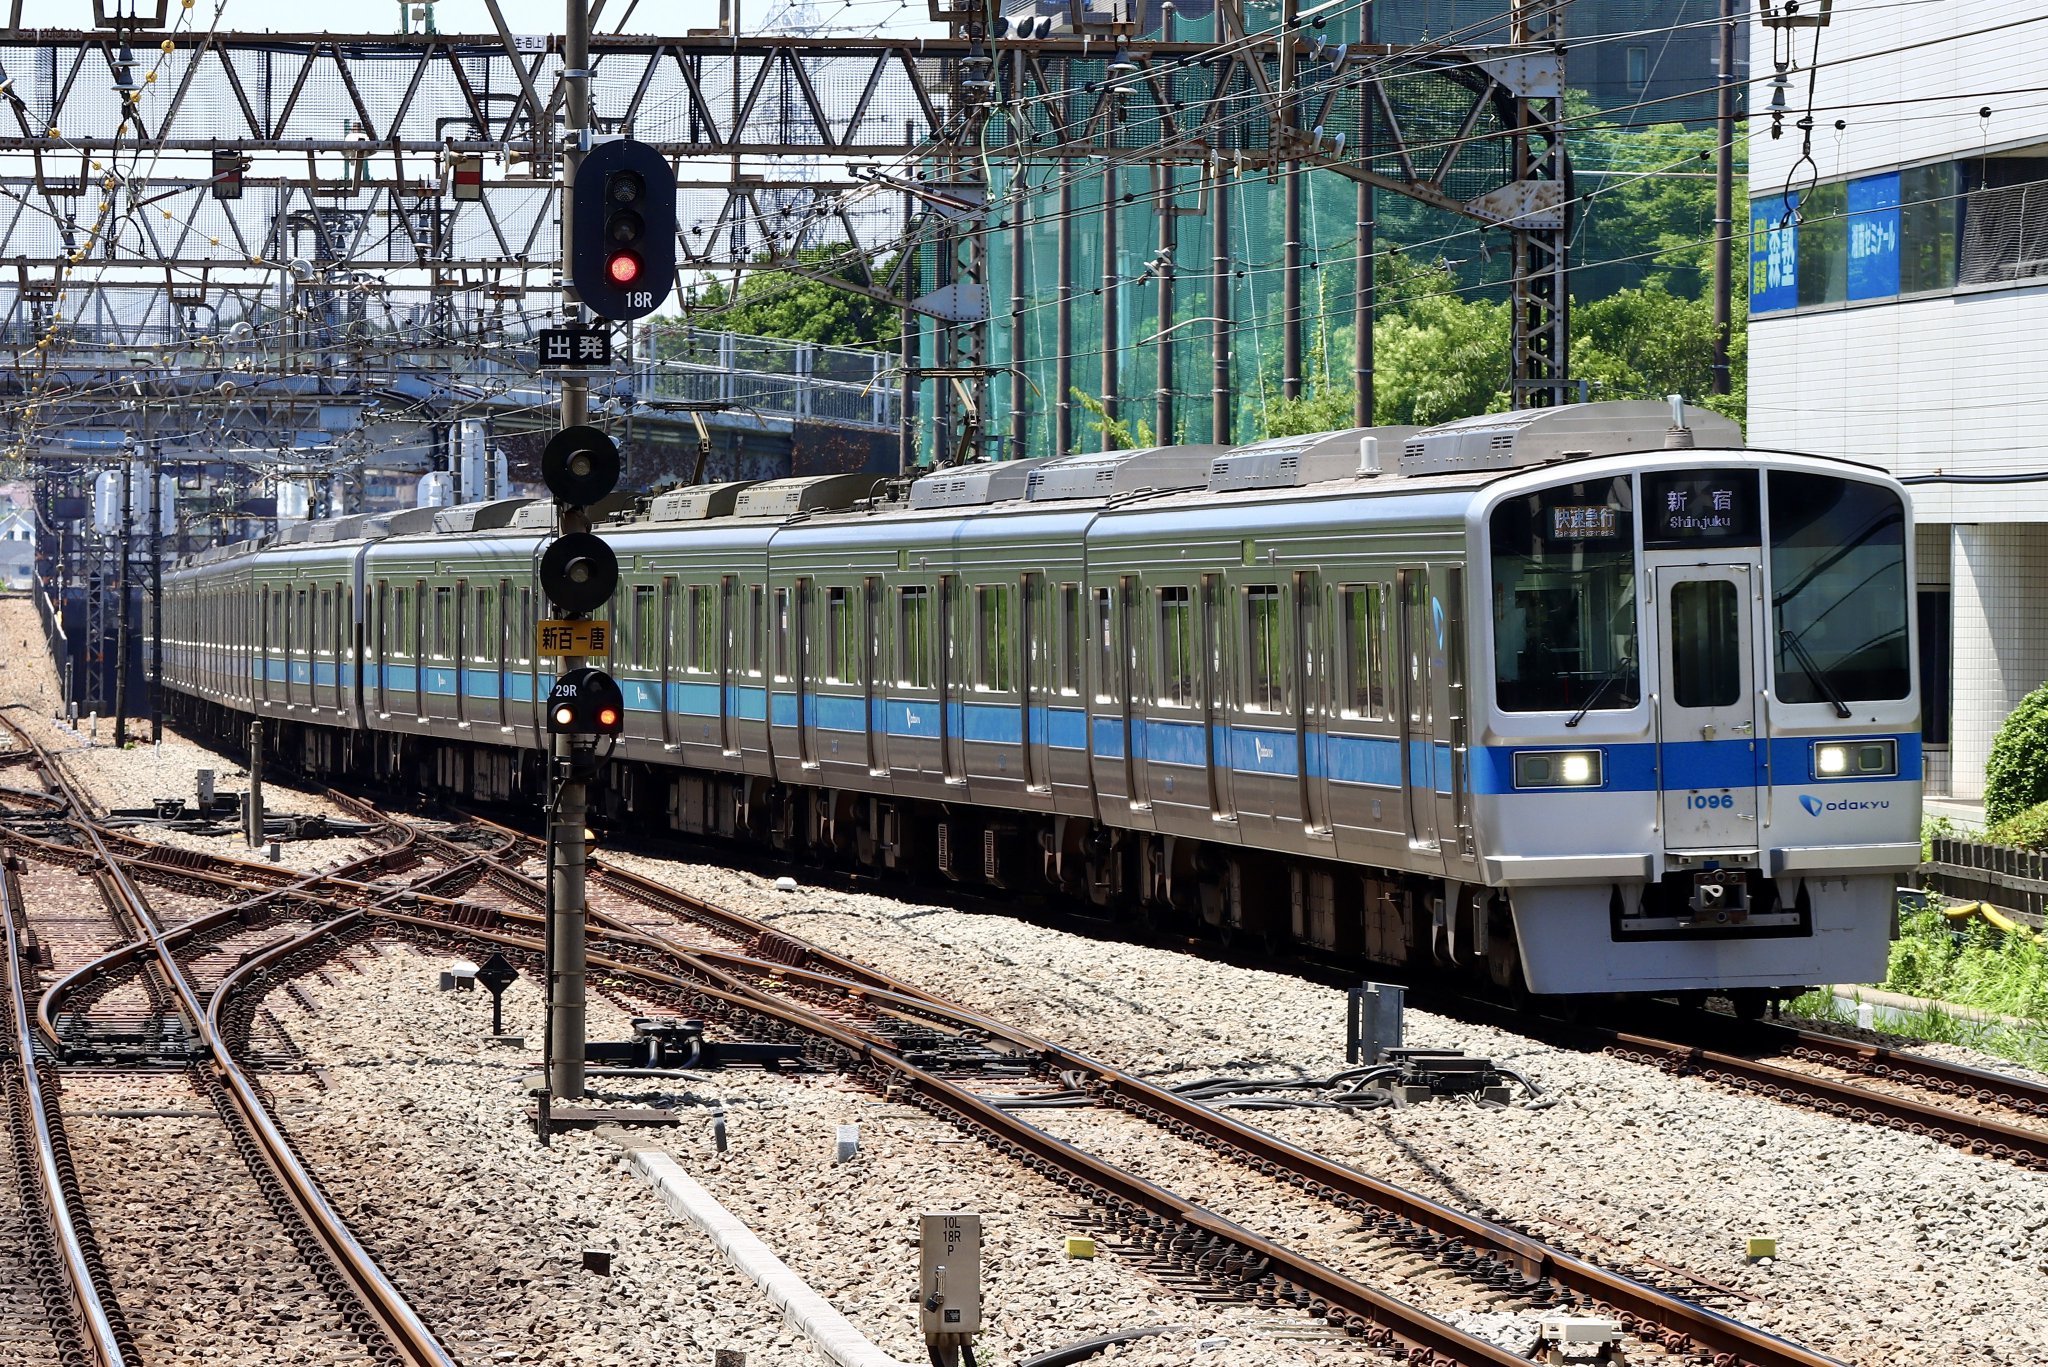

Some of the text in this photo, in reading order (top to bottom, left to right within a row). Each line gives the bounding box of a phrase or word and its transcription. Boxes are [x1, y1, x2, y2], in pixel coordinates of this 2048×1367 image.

[625, 291, 652, 308] 18R
[547, 335, 603, 359] 出発
[1554, 508, 1614, 528] 快速急行
[1670, 515, 1731, 530] Shinjuku
[555, 684, 577, 697] 29R
[1687, 794, 1734, 810] 1096
[943, 1216, 961, 1229] 10L
[943, 1230, 961, 1243] 18R
[947, 1244, 955, 1257] P
